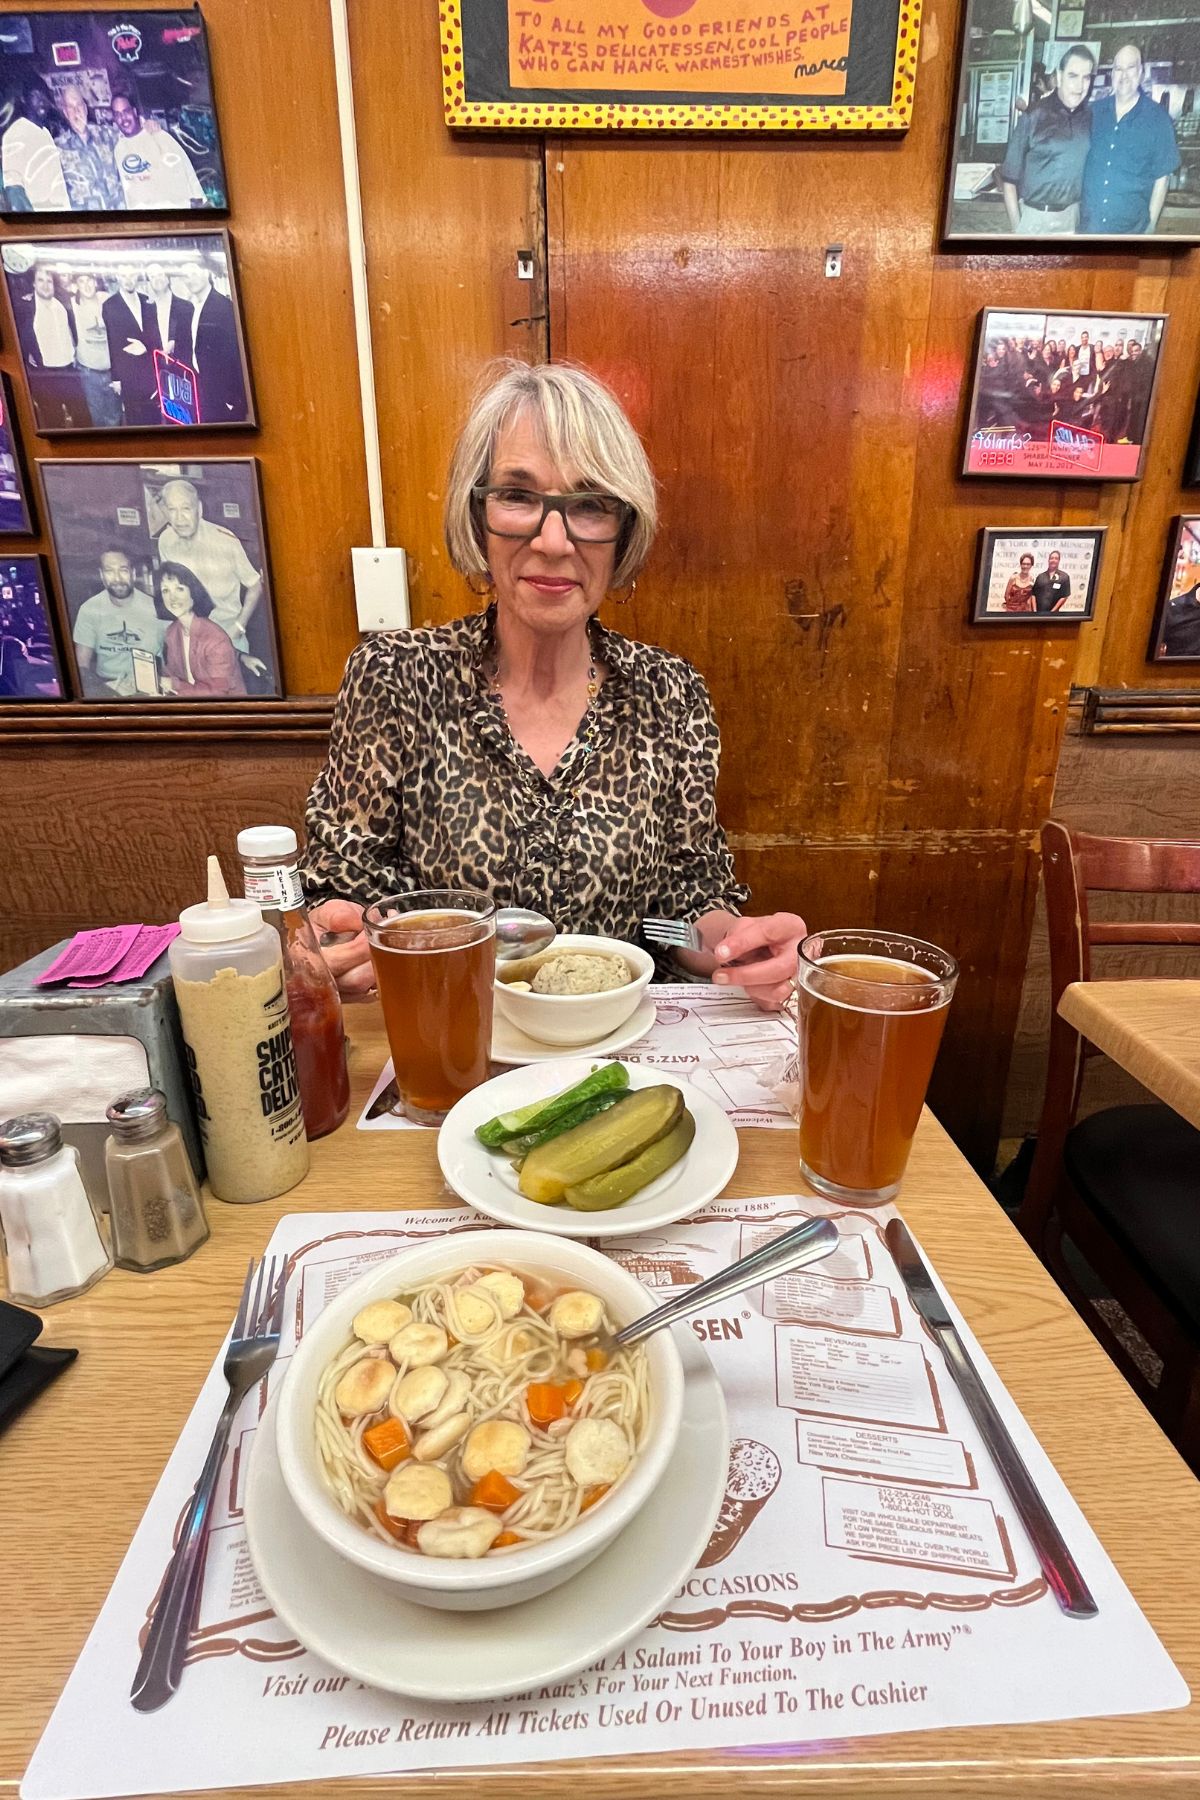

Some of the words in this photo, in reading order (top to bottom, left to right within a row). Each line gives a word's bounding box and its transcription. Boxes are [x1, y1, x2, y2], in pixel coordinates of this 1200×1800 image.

[515, 11, 541, 27] TO
[552, 17, 585, 34] ALL
[597, 24, 629, 40] MY
[643, 22, 691, 39] GOOD
[699, 14, 790, 36] FRIENDS
[801, 4, 830, 23] AT
[519, 32, 588, 58] KATZ'S
[737, 34, 779, 50] COOL
[786, 17, 848, 46] PEOPLE
[518, 56, 559, 71] WHO
[567, 59, 604, 72] CAN
[675, 54, 750, 73] WARMEST
[752, 47, 804, 67] WISHES.
[277, 870, 288, 903] HEINZ
[405, 1216, 455, 1225] Welcome
[459, 1214, 470, 1222] to
[709, 1205, 740, 1213] Since
[824, 1337, 868, 1348] BEVERAGES
[855, 1432, 898, 1444] DESSERTS
[611, 1650, 627, 1670] A
[633, 1644, 701, 1669] Salami
[709, 1643, 732, 1663] To
[739, 1640, 783, 1661] Your
[789, 1636, 826, 1661] Boy
[833, 1634, 851, 1654] in
[858, 1631, 896, 1652] The
[262, 1673, 309, 1697] Visit
[313, 1676, 350, 1693] our
[596, 1676, 625, 1694] For
[633, 1674, 669, 1693] Your
[675, 1670, 713, 1689] Next
[719, 1664, 797, 1685] Function.
[319, 1724, 390, 1750] Please
[395, 1718, 471, 1743] Return
[476, 1711, 510, 1737] All
[518, 1708, 589, 1734] Tickets
[599, 1701, 648, 1728] Used
[655, 1699, 683, 1722] Or
[691, 1692, 767, 1720] Unused
[775, 1690, 798, 1713] To
[805, 1687, 844, 1711] The
[851, 1680, 928, 1707] Cashier
